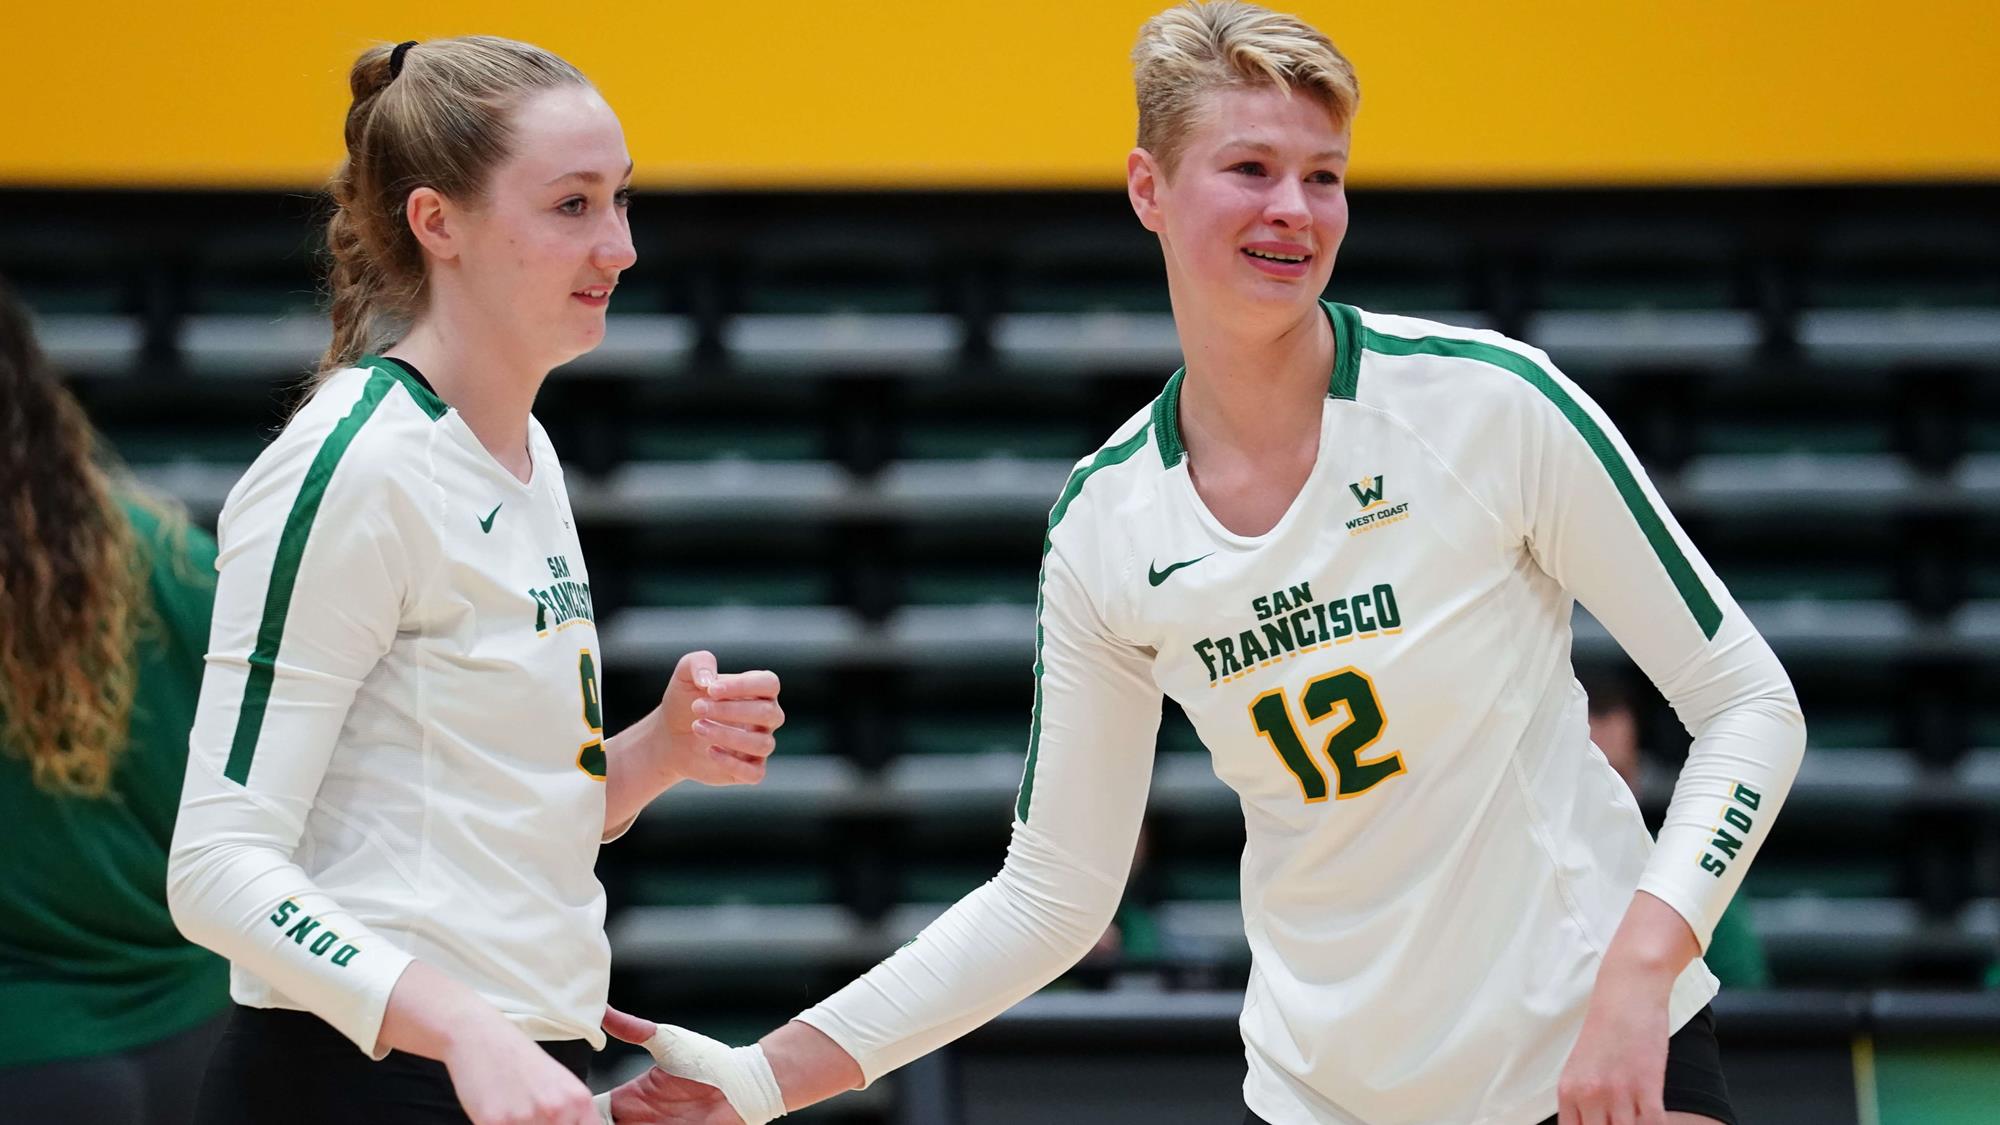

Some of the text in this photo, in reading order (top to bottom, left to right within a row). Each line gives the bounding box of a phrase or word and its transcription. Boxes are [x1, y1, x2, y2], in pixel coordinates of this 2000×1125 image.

[1346, 502, 1408, 529] WEST COAST
[1349, 475, 1383, 507] W
[1349, 512, 1409, 537] CONFERENCE
[547, 555, 570, 578] SAN
[1252, 581, 1313, 621] SAN
[1193, 583, 1402, 682] FRANCISCO
[576, 648, 606, 782] 9
[1248, 665, 1407, 804] 12
[1700, 783, 1761, 878] DONS
[270, 900, 360, 967] DONS
